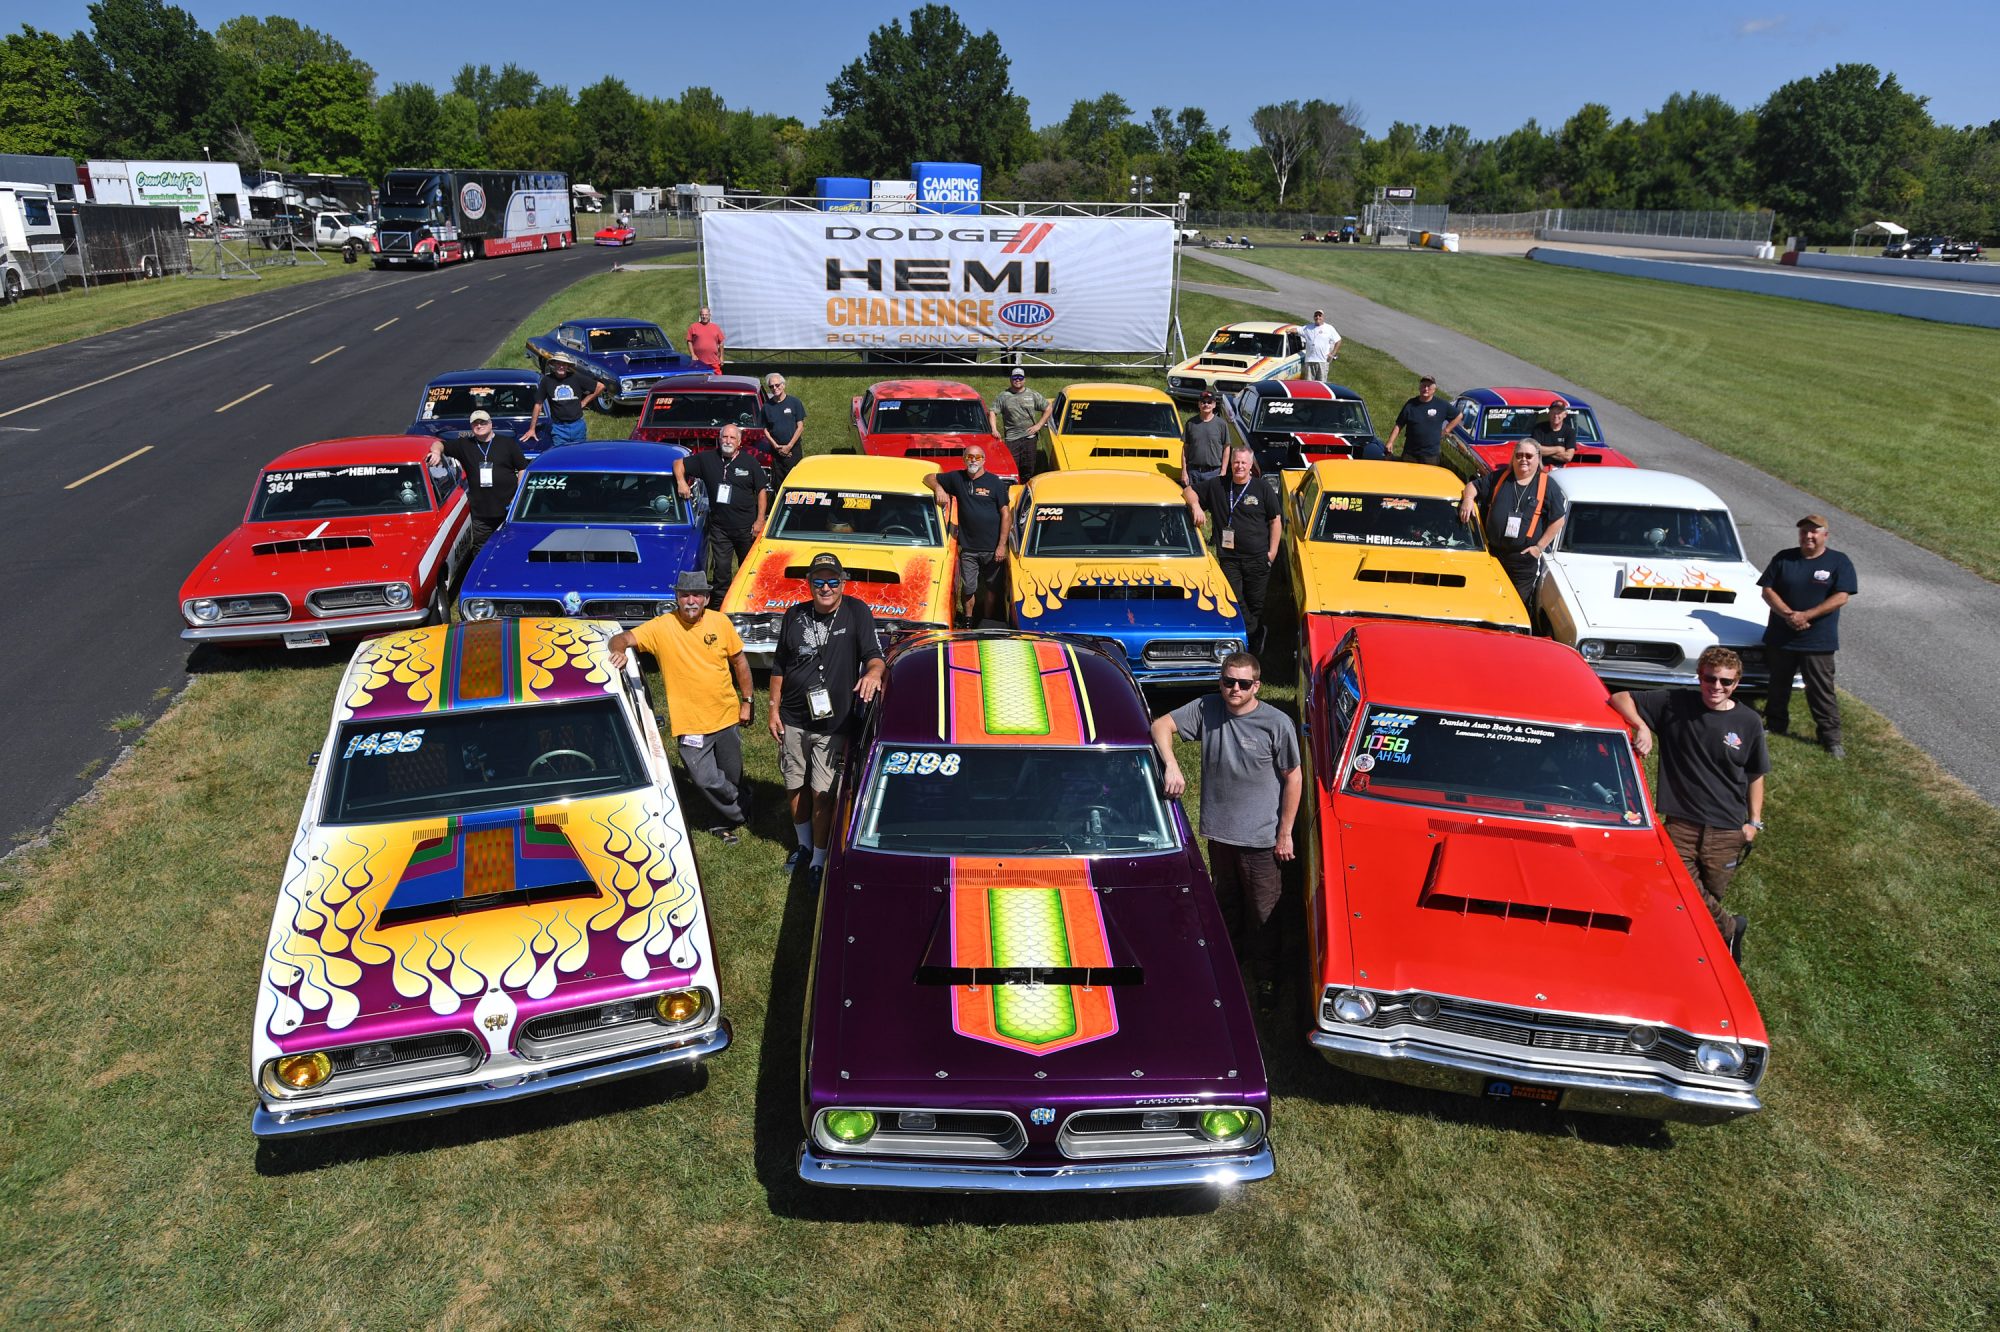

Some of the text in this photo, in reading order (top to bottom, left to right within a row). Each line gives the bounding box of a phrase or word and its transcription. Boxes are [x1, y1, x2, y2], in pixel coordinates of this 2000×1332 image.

[922, 177, 979, 191] CAMPING
[922, 190, 979, 204] WORLD
[828, 204, 867, 212] GOODYEA
[825, 226, 1023, 243] DODGE
[826, 257, 1051, 294] HEMI
[826, 297, 994, 327] CHALLENGE
[1006, 303, 1049, 325] NHRA
[827, 333, 1054, 344] 20TH ANNIVERSARY
[348, 466, 377, 477] HEMI
[376, 467, 399, 475] Clash
[528, 475, 569, 486] 498Z
[267, 482, 294, 494] 364
[784, 491, 816, 505] 1979
[1329, 496, 1349, 511] 350
[1366, 534, 1393, 545] HEMI
[1393, 538, 1424, 546] Shootout
[1439, 718, 1471, 728] Daniels
[1471, 721, 1491, 730] Auto
[1492, 723, 1514, 733] Body
[1524, 727, 1555, 737] Custom
[343, 728, 426, 760] 1426
[1362, 734, 1410, 753] 1058
[884, 751, 962, 777] 2198
[1375, 750, 1412, 764] AH/SM
[1135, 1097, 1200, 1105] PLYMOUTH
